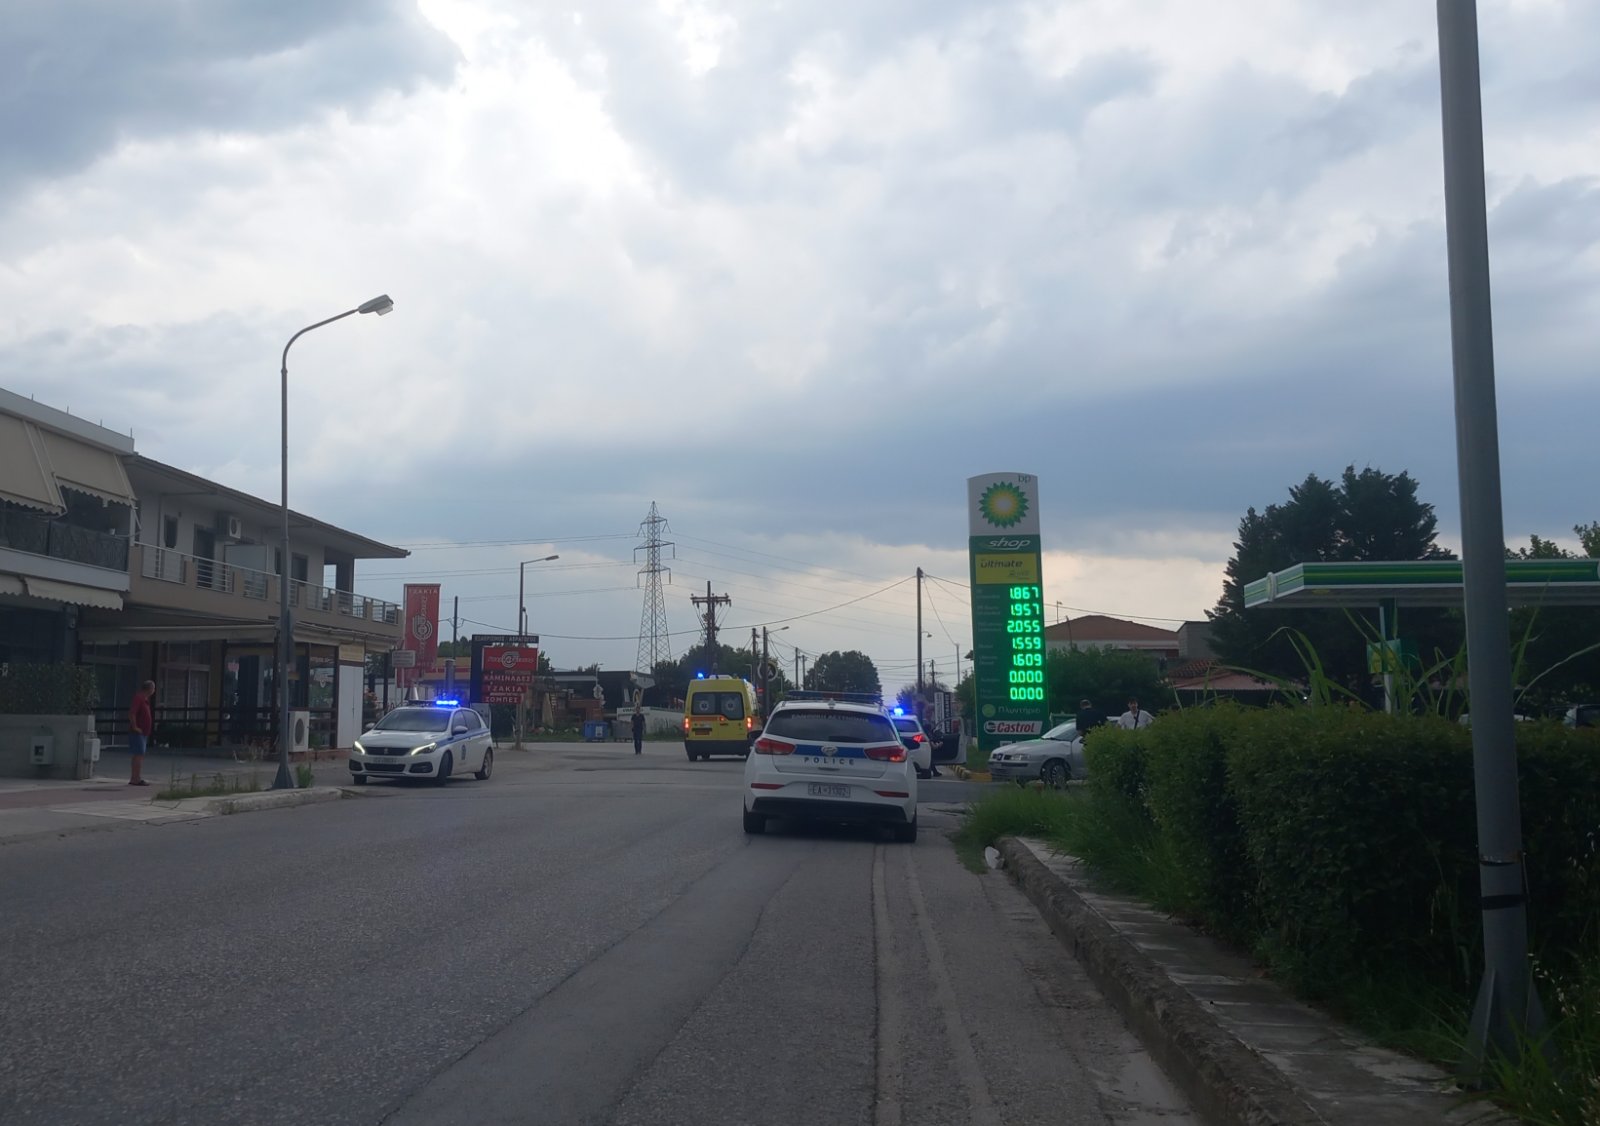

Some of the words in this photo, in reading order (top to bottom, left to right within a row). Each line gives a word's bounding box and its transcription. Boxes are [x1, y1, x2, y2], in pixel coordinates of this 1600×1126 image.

[1018, 475, 1032, 483] bp
[989, 537, 1031, 550] shop
[996, 722, 1036, 733] Castrol
[804, 757, 854, 765] POLICE
